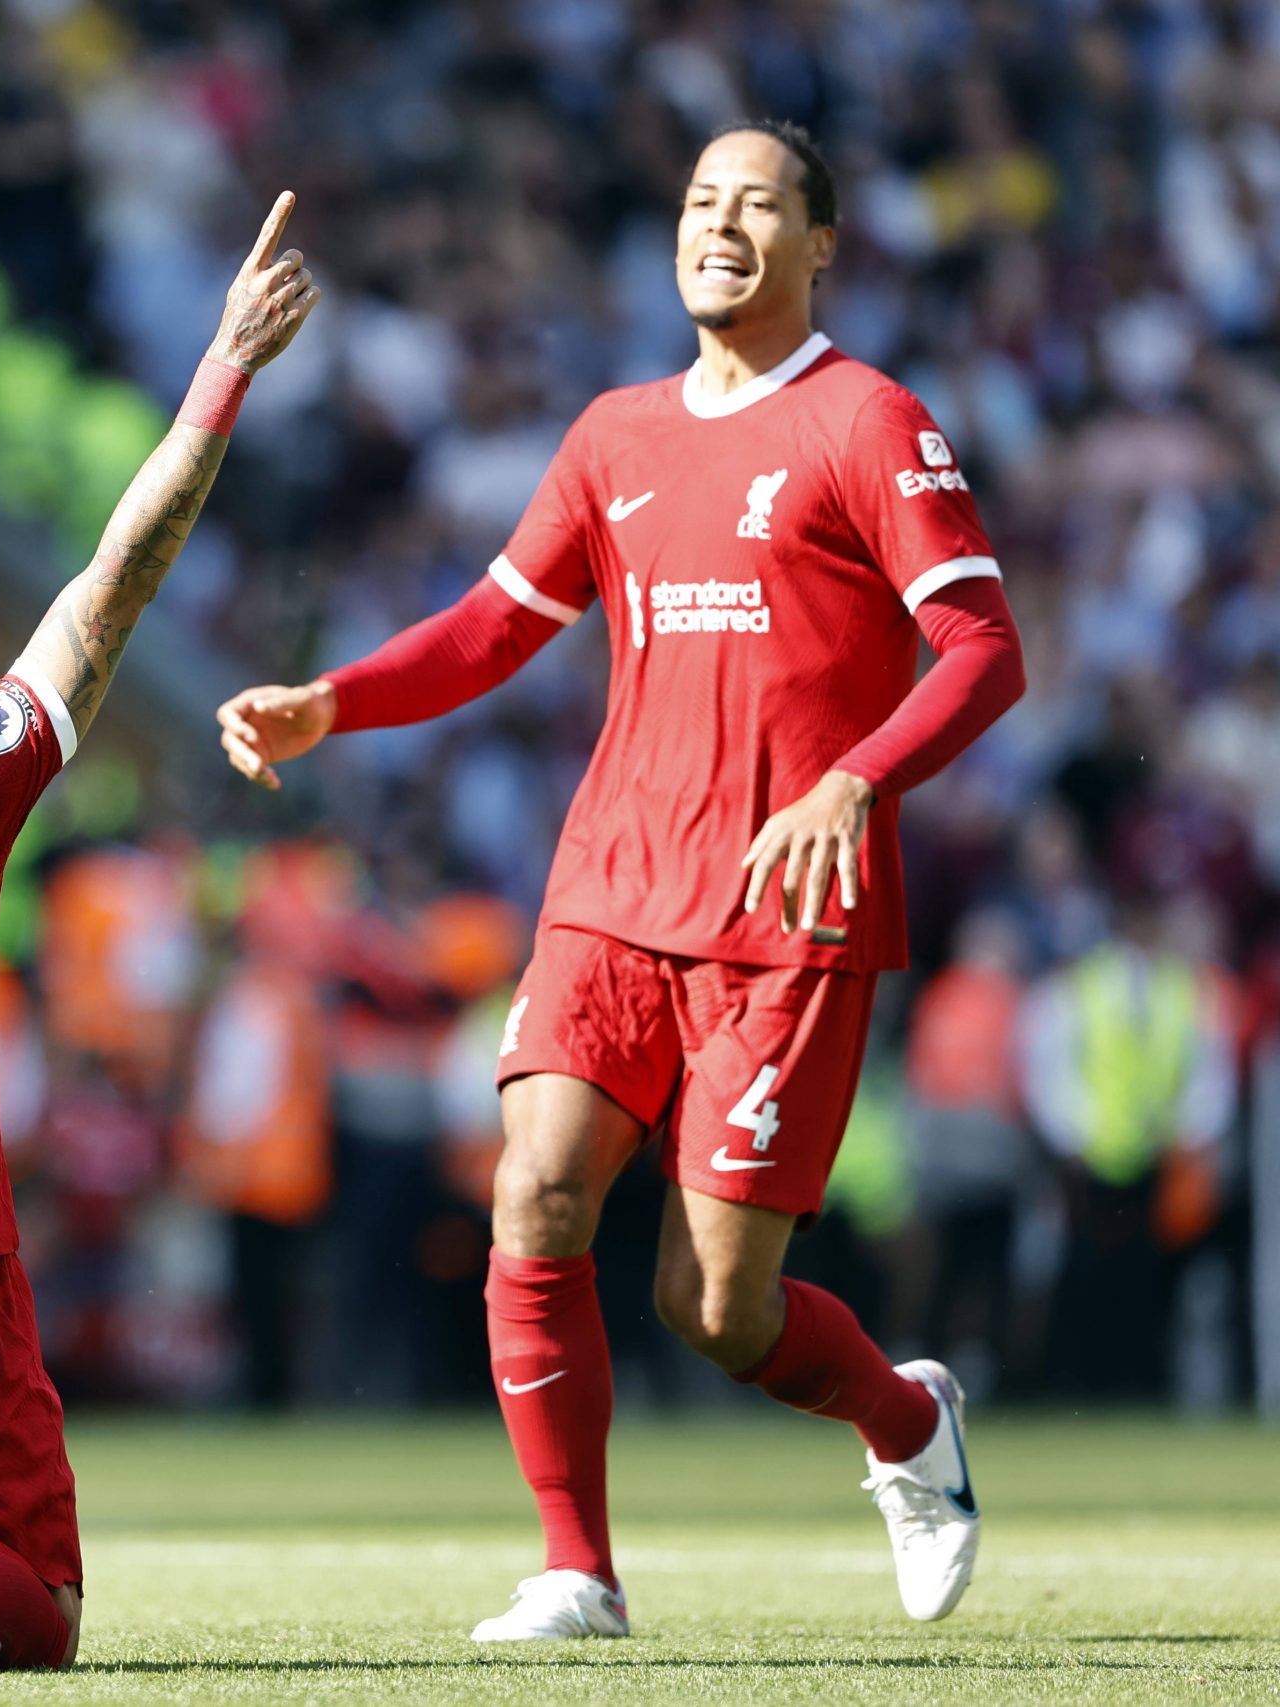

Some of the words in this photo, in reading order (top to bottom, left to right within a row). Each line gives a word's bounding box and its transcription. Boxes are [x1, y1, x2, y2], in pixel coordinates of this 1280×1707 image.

[650, 577, 762, 609] standard
[653, 605, 770, 634] chartered
[726, 1064, 781, 1152] 4
